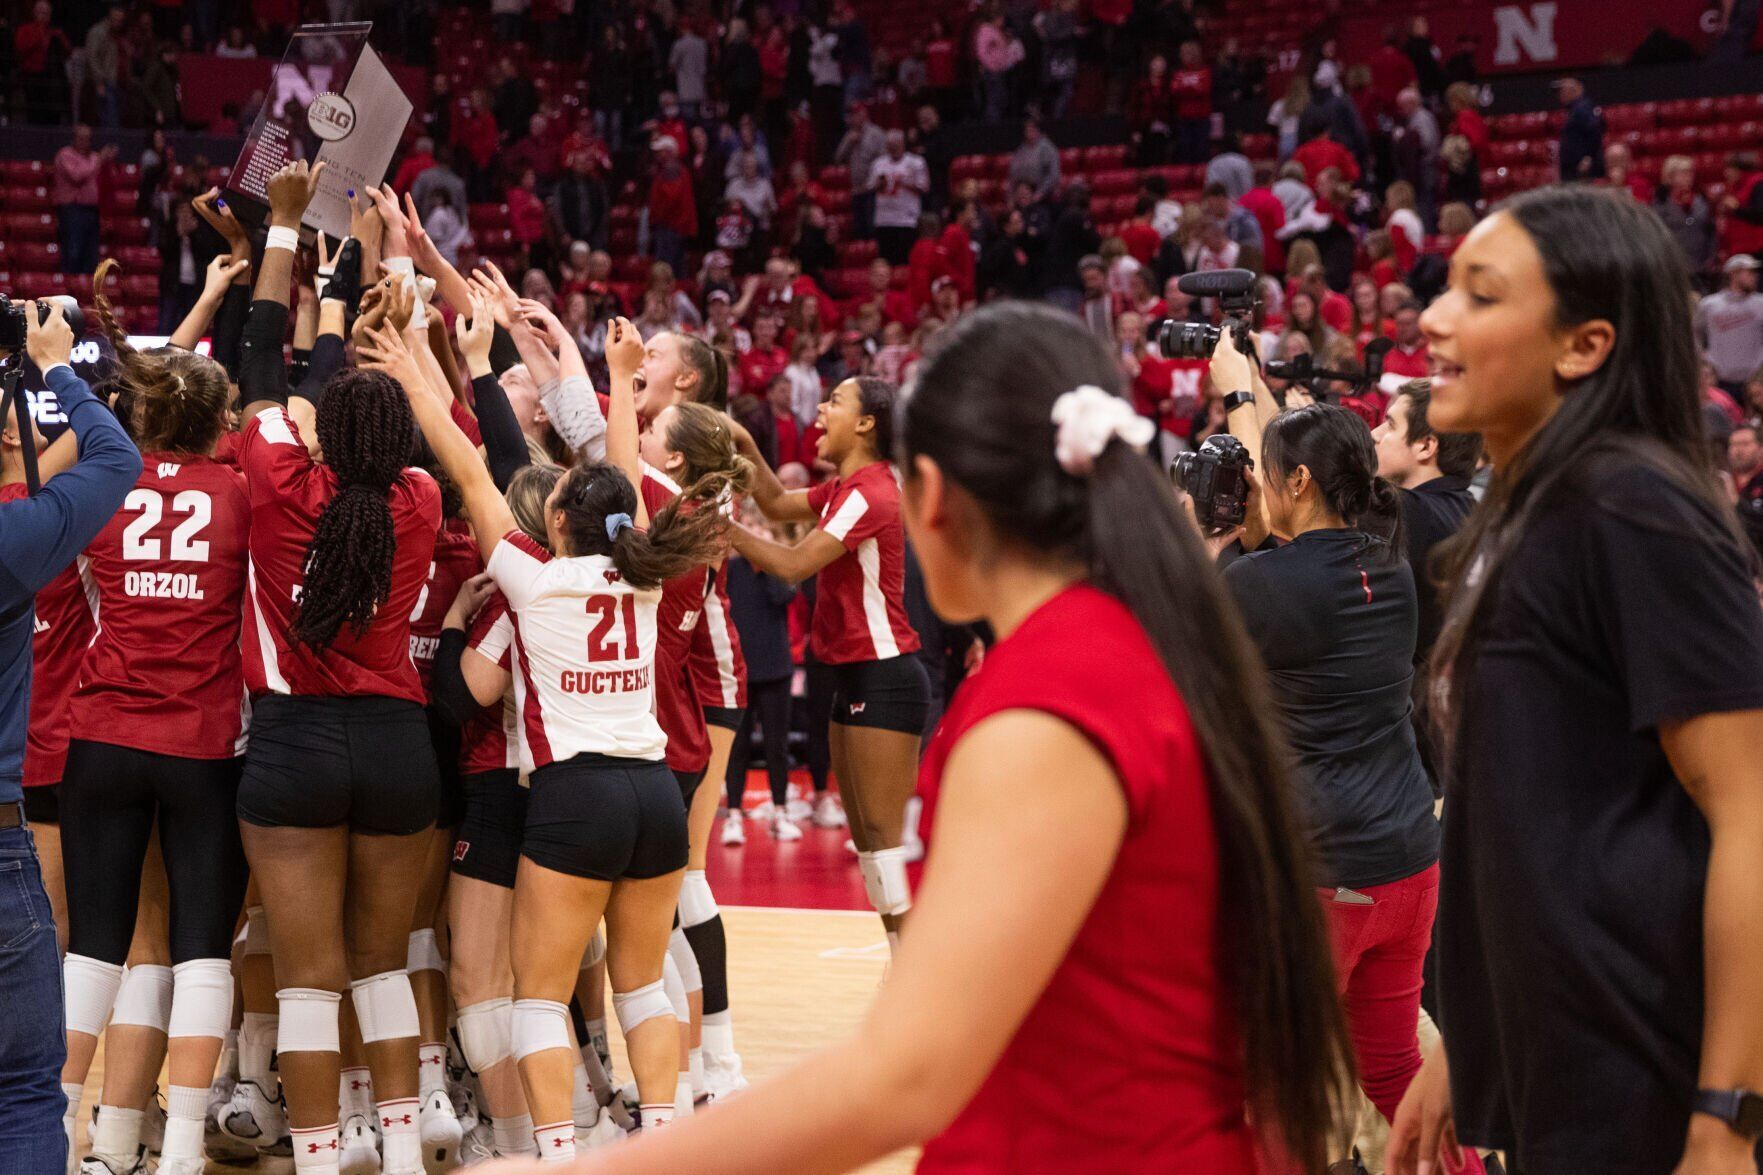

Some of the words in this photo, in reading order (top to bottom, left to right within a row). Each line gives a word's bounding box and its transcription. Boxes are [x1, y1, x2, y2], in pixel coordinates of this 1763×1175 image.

[1493, 2, 1558, 65] N
[123, 488, 212, 562] 22
[124, 571, 204, 600] ORZOL
[585, 593, 640, 663] 21
